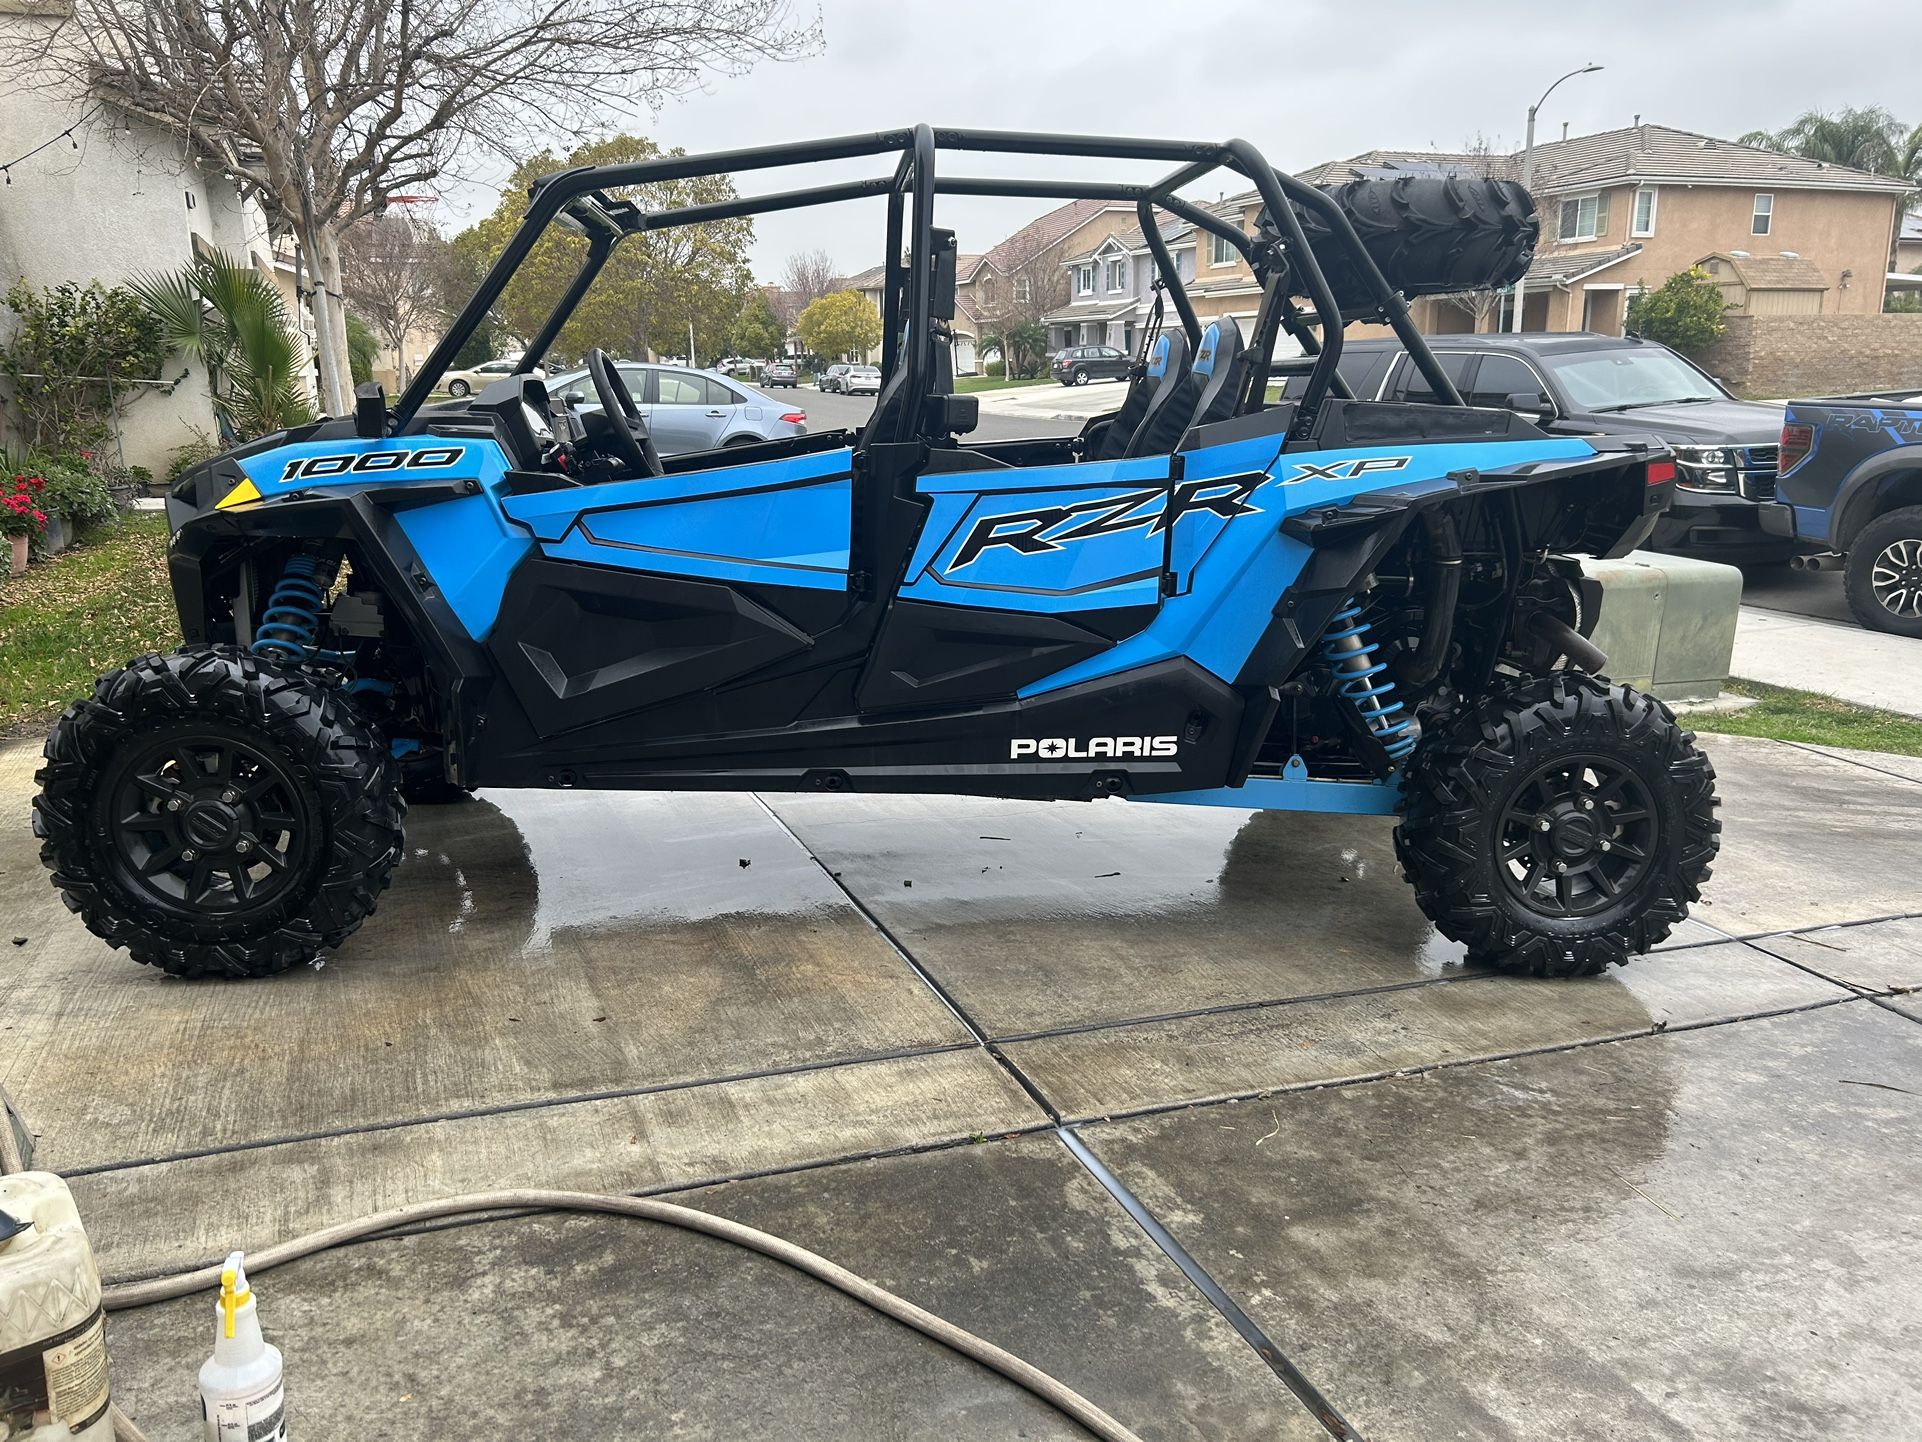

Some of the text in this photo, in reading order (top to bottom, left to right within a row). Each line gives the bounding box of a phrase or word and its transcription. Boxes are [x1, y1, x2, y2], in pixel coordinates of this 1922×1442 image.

[1825, 413, 1922, 435] RAPT
[279, 446, 466, 483] 1000
[944, 456, 1413, 575] RZR XP
[1010, 735, 1178, 759] POLARIS
